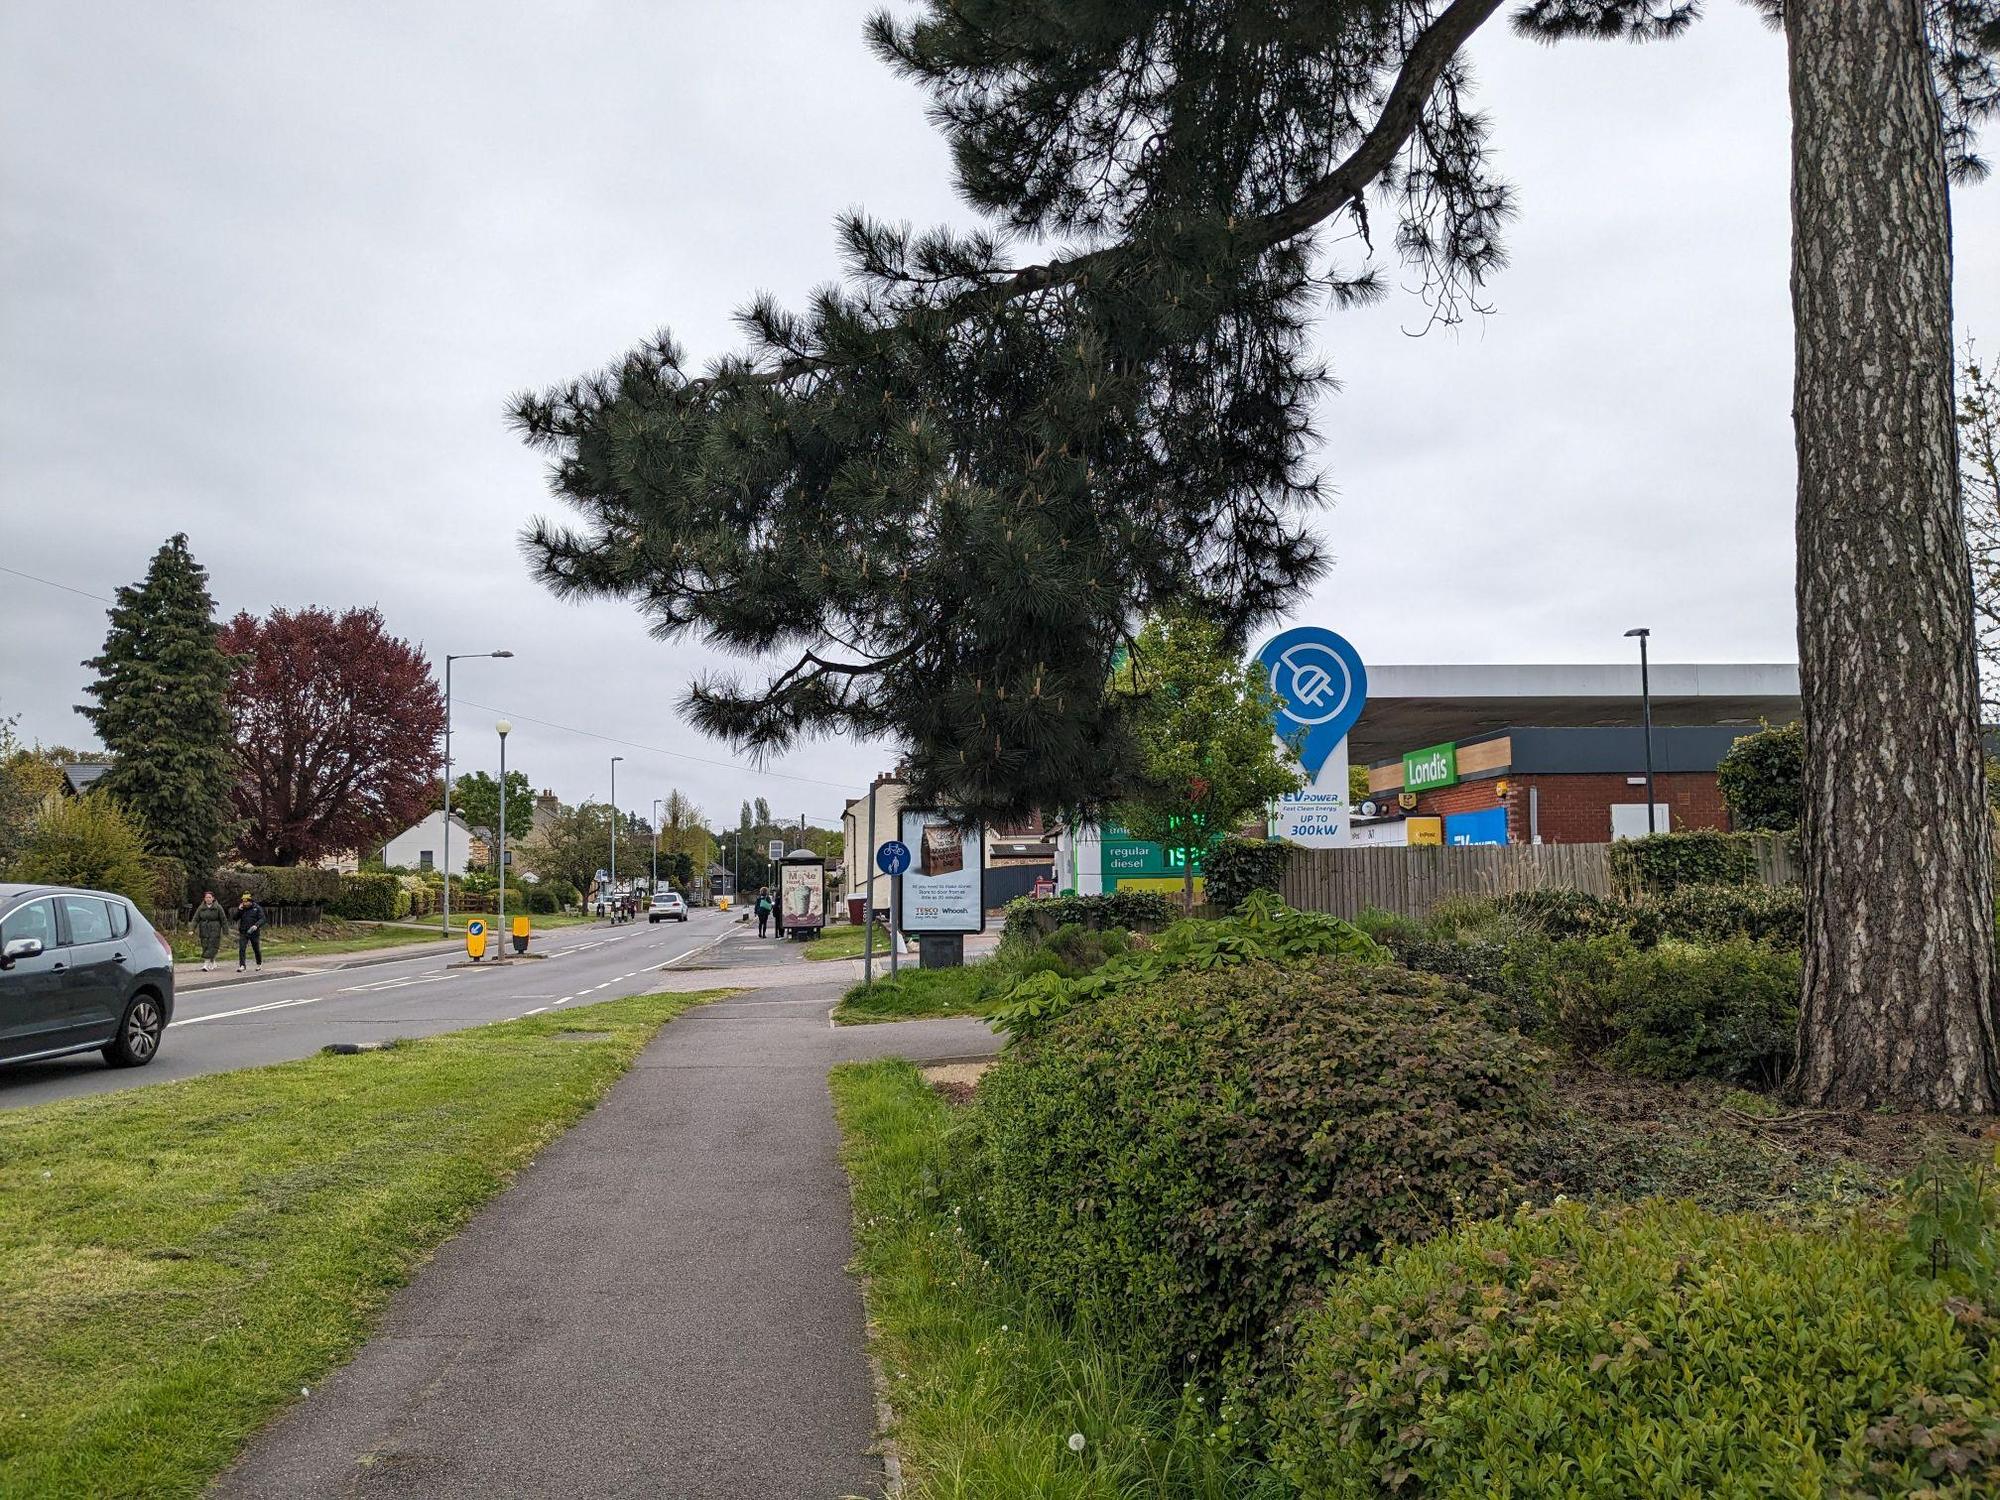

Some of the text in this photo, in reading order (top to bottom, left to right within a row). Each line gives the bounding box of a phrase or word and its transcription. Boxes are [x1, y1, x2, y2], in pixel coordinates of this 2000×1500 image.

[1409, 752, 1447, 785] Londis
[1300, 815, 1328, 823] UP TO
[1291, 825, 1338, 836] 300kW
[1110, 846, 1150, 858] regular
[1110, 858, 1144, 868] diesel
